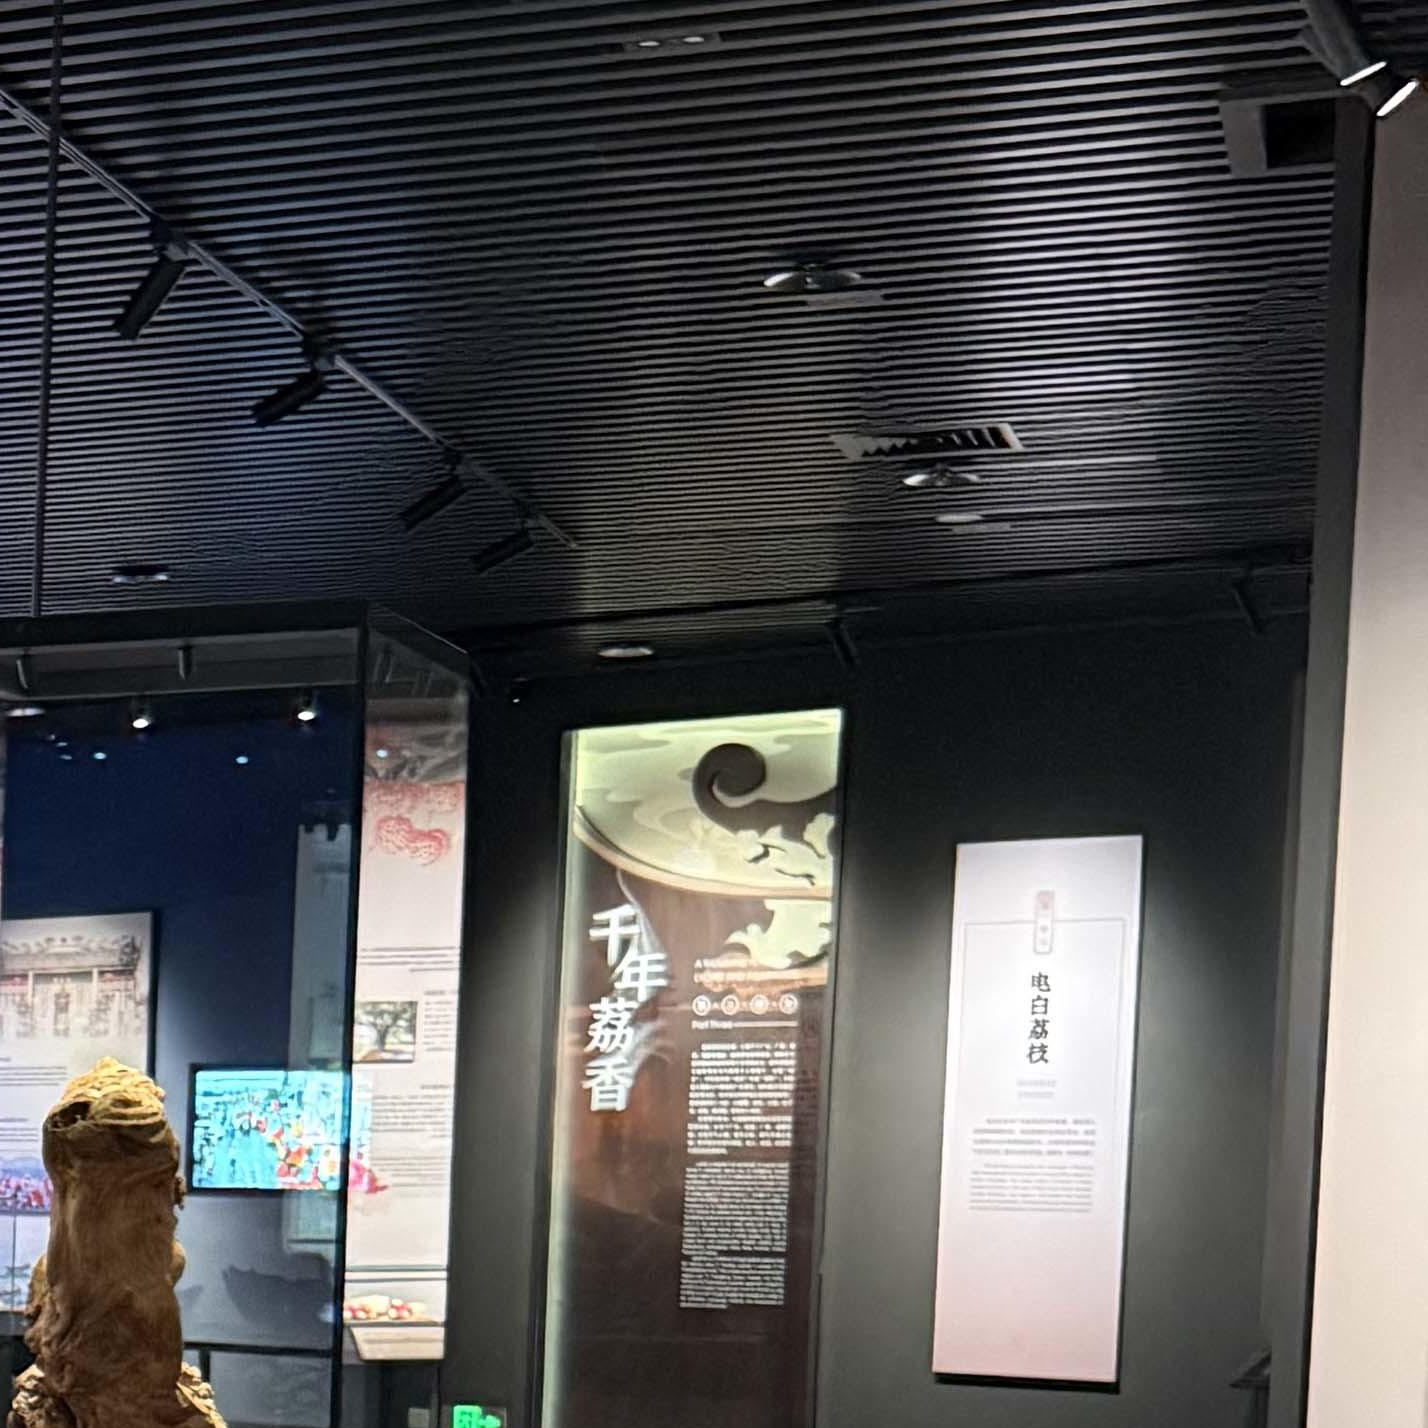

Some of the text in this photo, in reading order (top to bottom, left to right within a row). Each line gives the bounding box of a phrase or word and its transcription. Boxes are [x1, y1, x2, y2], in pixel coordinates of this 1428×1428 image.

[581, 903, 669, 1112] 千年荔香
[1025, 971, 1052, 1065] 电白荔枝
